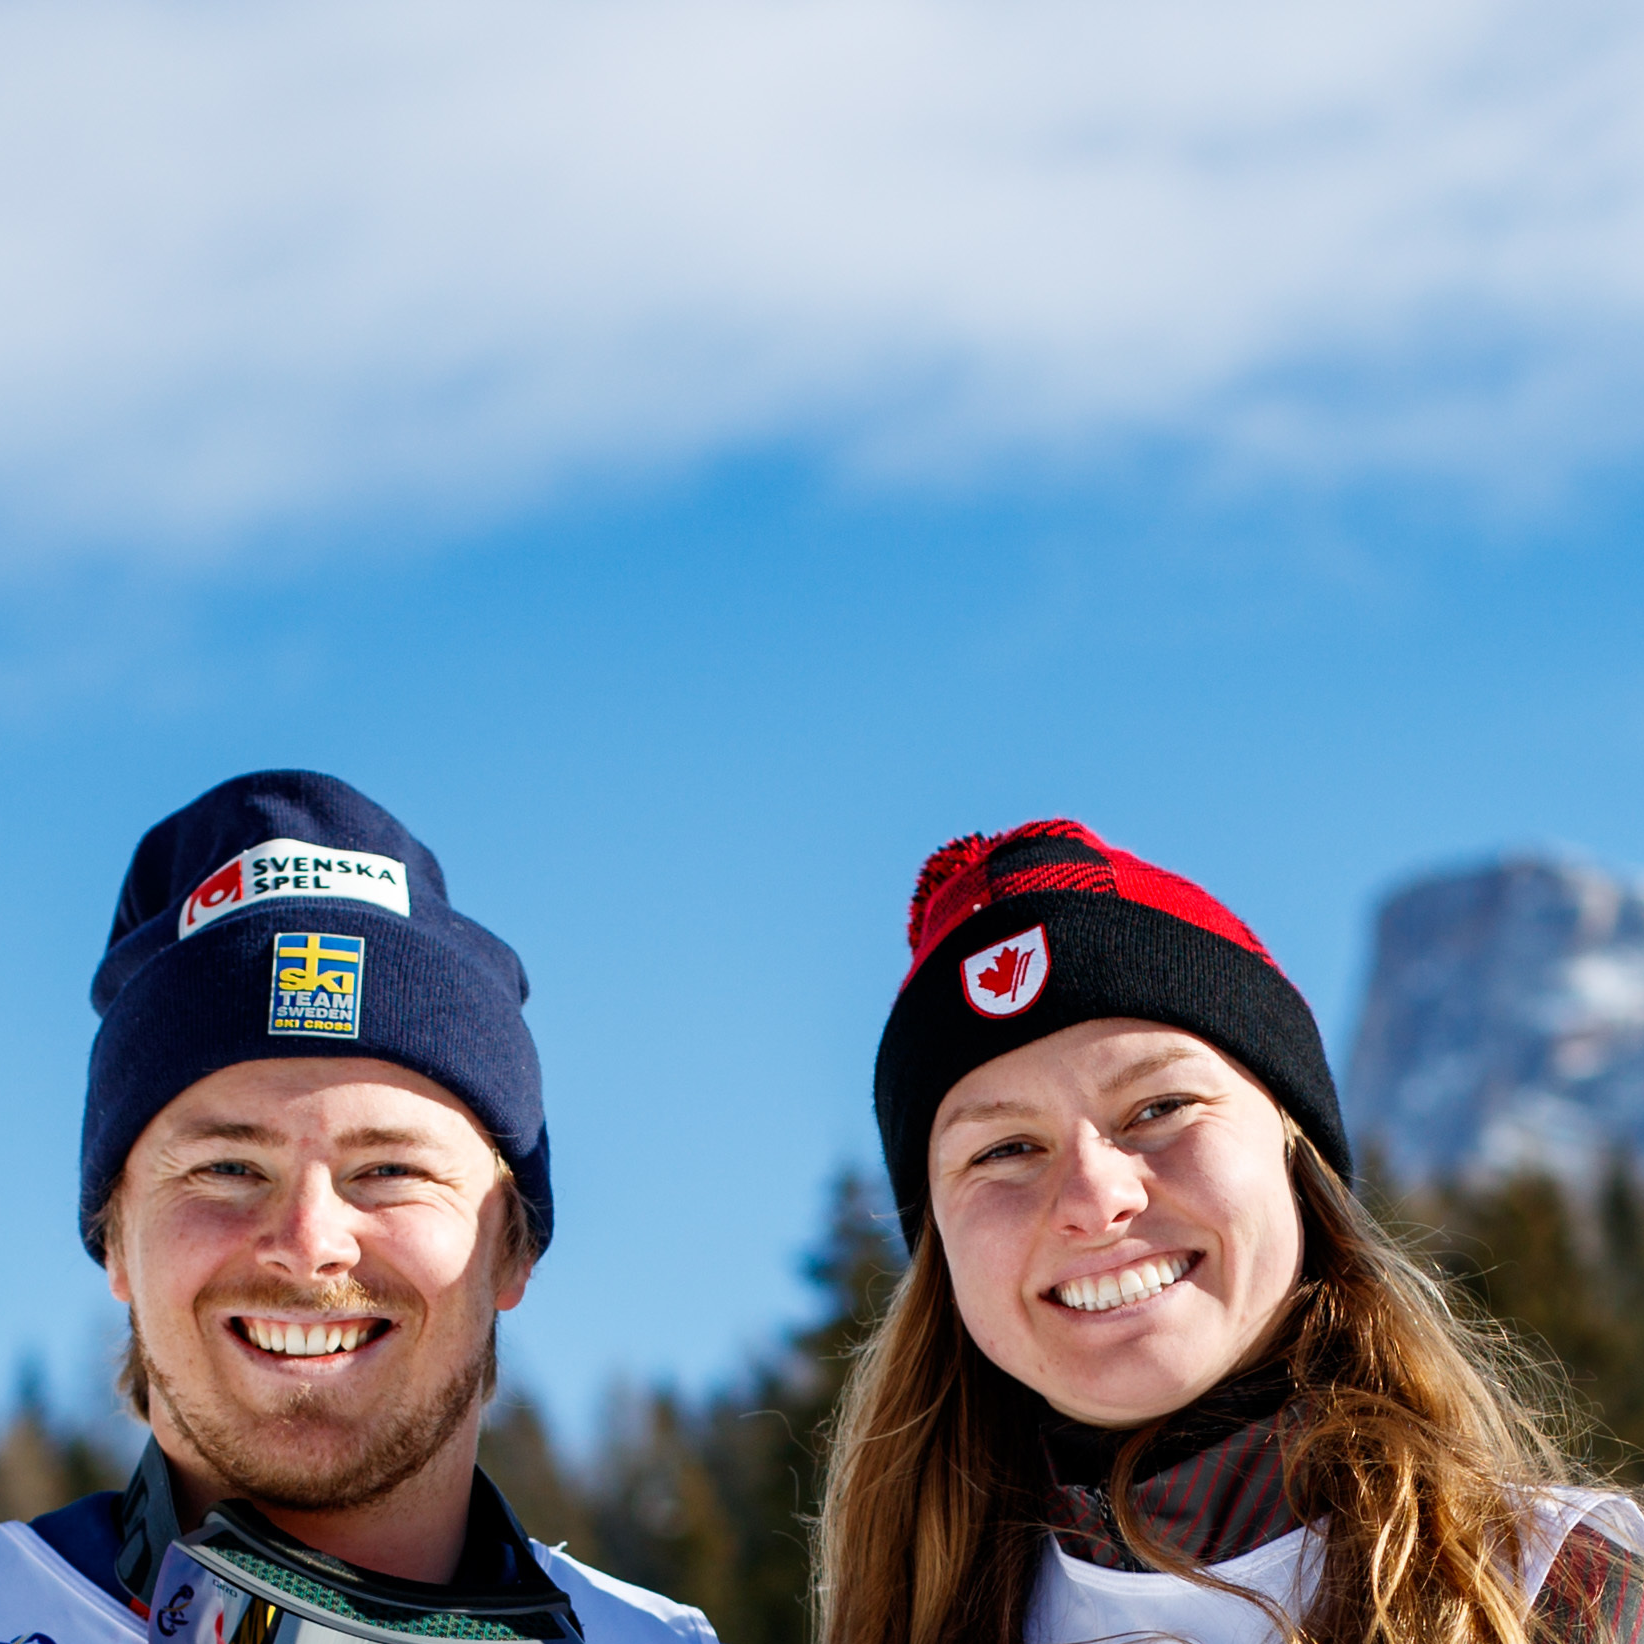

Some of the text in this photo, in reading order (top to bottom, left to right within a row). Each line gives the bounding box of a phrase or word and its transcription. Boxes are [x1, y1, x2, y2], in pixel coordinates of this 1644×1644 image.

[253, 857, 396, 885] SVENSKA
[254, 875, 330, 895] SPEL
[278, 967, 354, 995] SKI
[278, 991, 354, 1009] TEAM
[276, 1006, 353, 1020] SWEDEN
[274, 1018, 353, 1032] SKI CROSS
